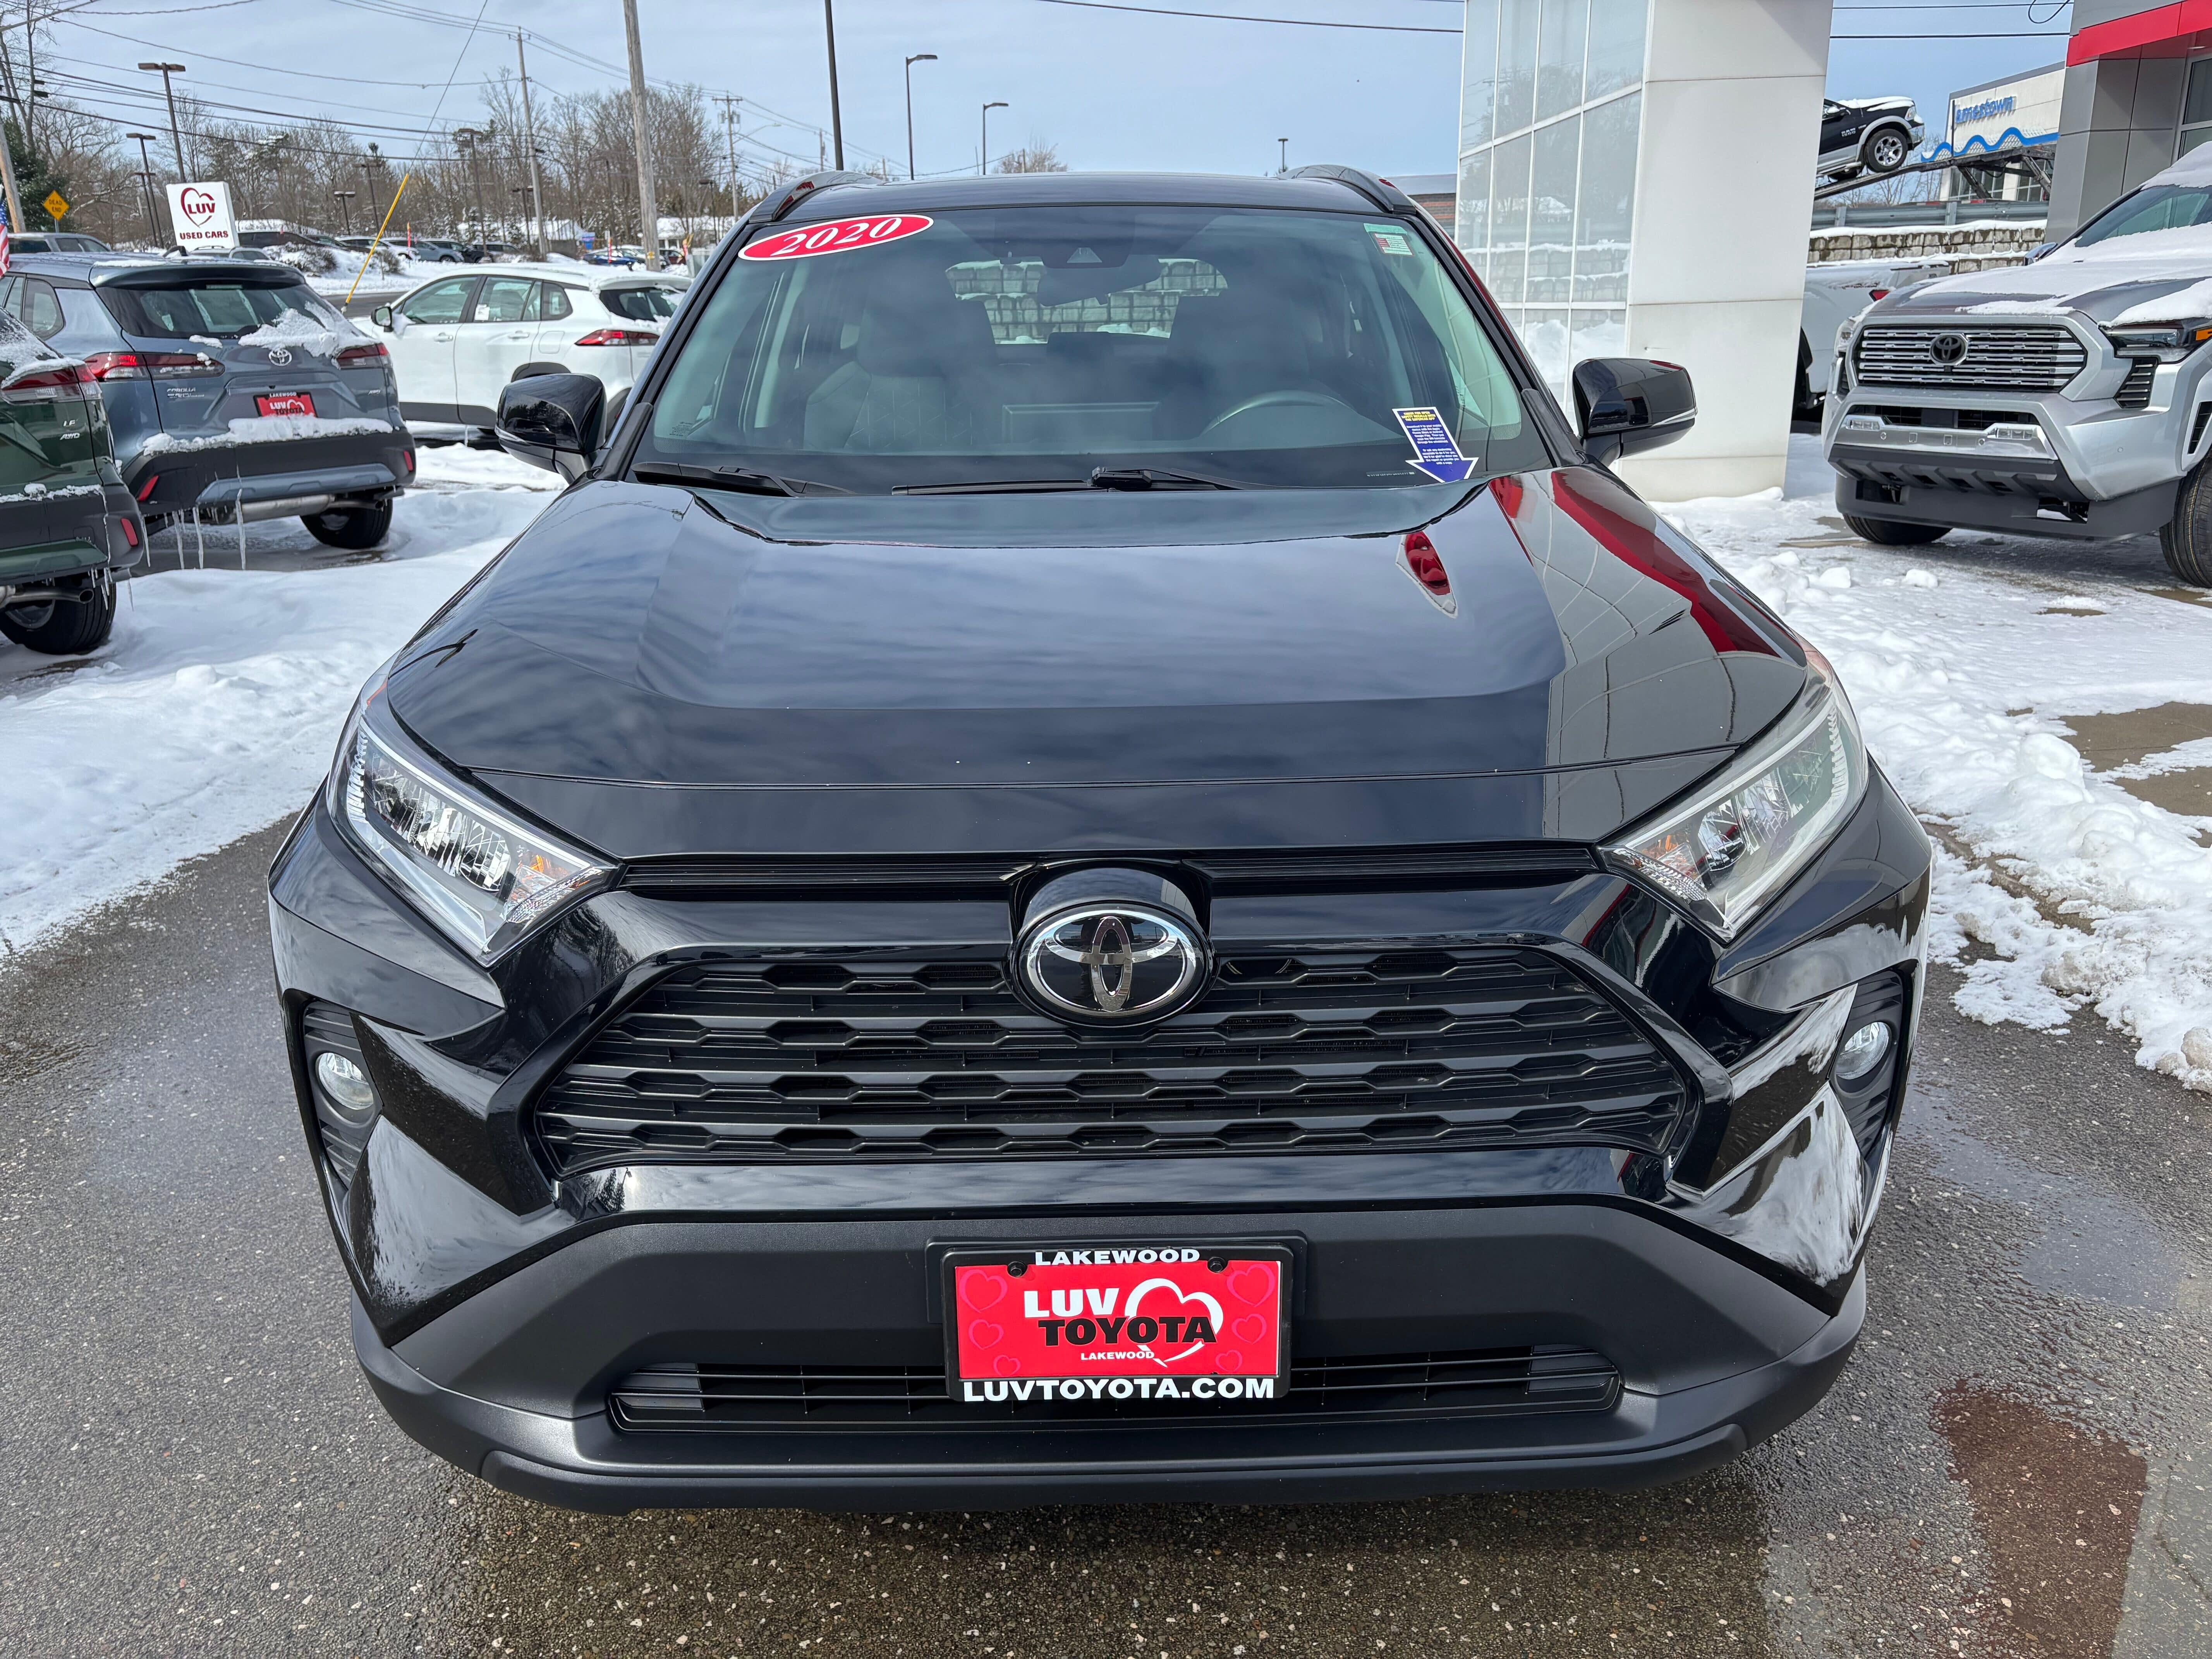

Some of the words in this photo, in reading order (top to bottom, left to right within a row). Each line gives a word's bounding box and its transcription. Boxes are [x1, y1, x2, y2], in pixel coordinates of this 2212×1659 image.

[187, 203, 215, 214] LUV
[205, 230, 228, 239] CARS
[770, 217, 902, 257] 2020
[60, 432, 80, 440] AWD
[1035, 1249, 1200, 1266] LAKEWOOD
[1024, 1288, 1120, 1317] LUV
[1038, 1317, 1216, 1346] TOYOTA
[1080, 1350, 1155, 1360] LAKEWOOD
[963, 1378, 1274, 1402] LUVTOYOTA.COM
